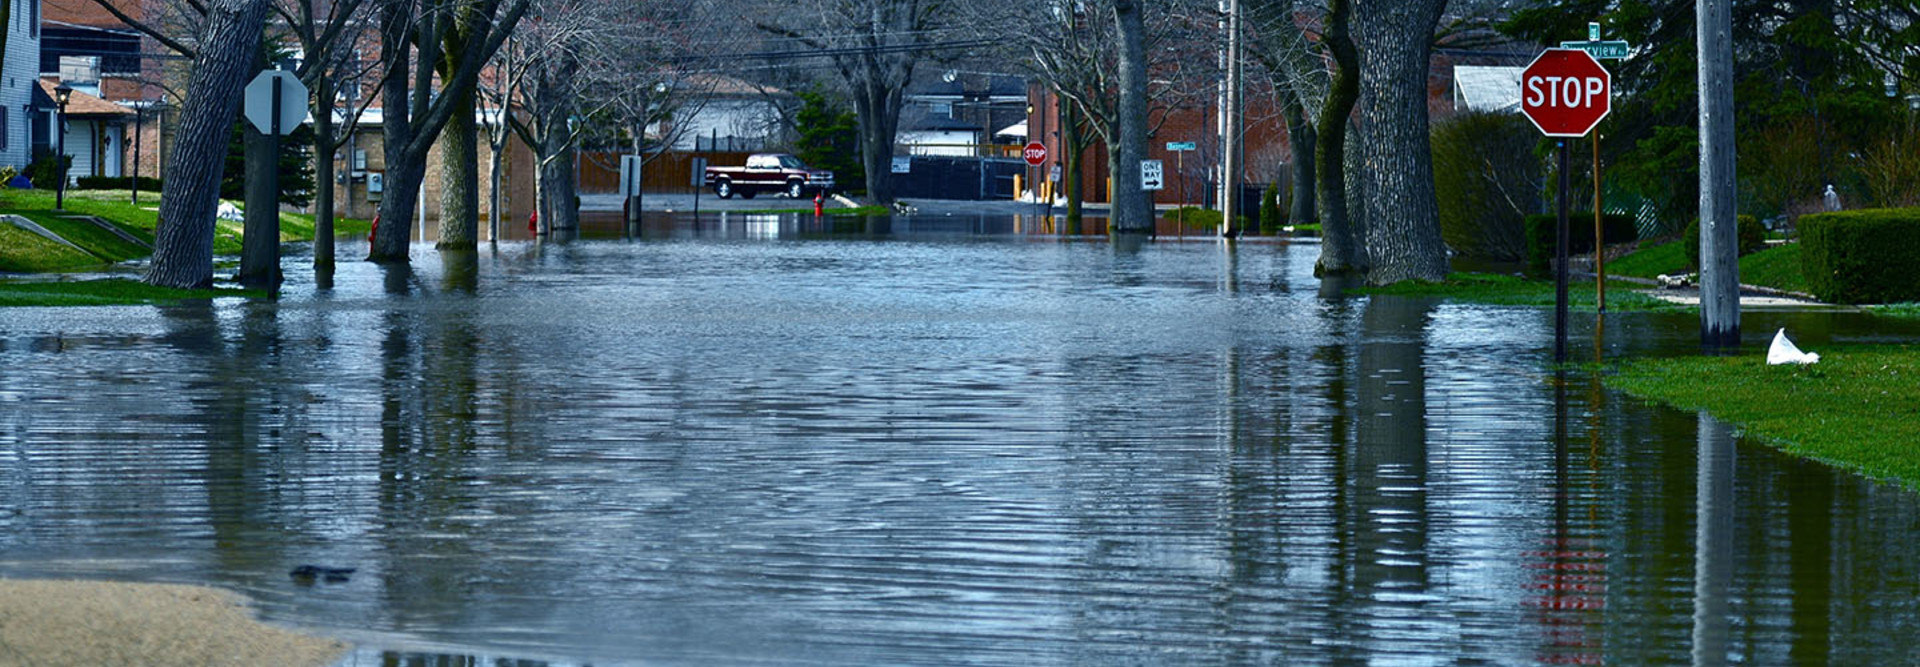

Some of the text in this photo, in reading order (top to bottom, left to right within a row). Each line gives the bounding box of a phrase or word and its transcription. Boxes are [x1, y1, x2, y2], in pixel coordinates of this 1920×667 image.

[1563, 44, 1617, 57] rview
[1527, 75, 1604, 108] STOP
[1025, 148, 1046, 159] STOP
